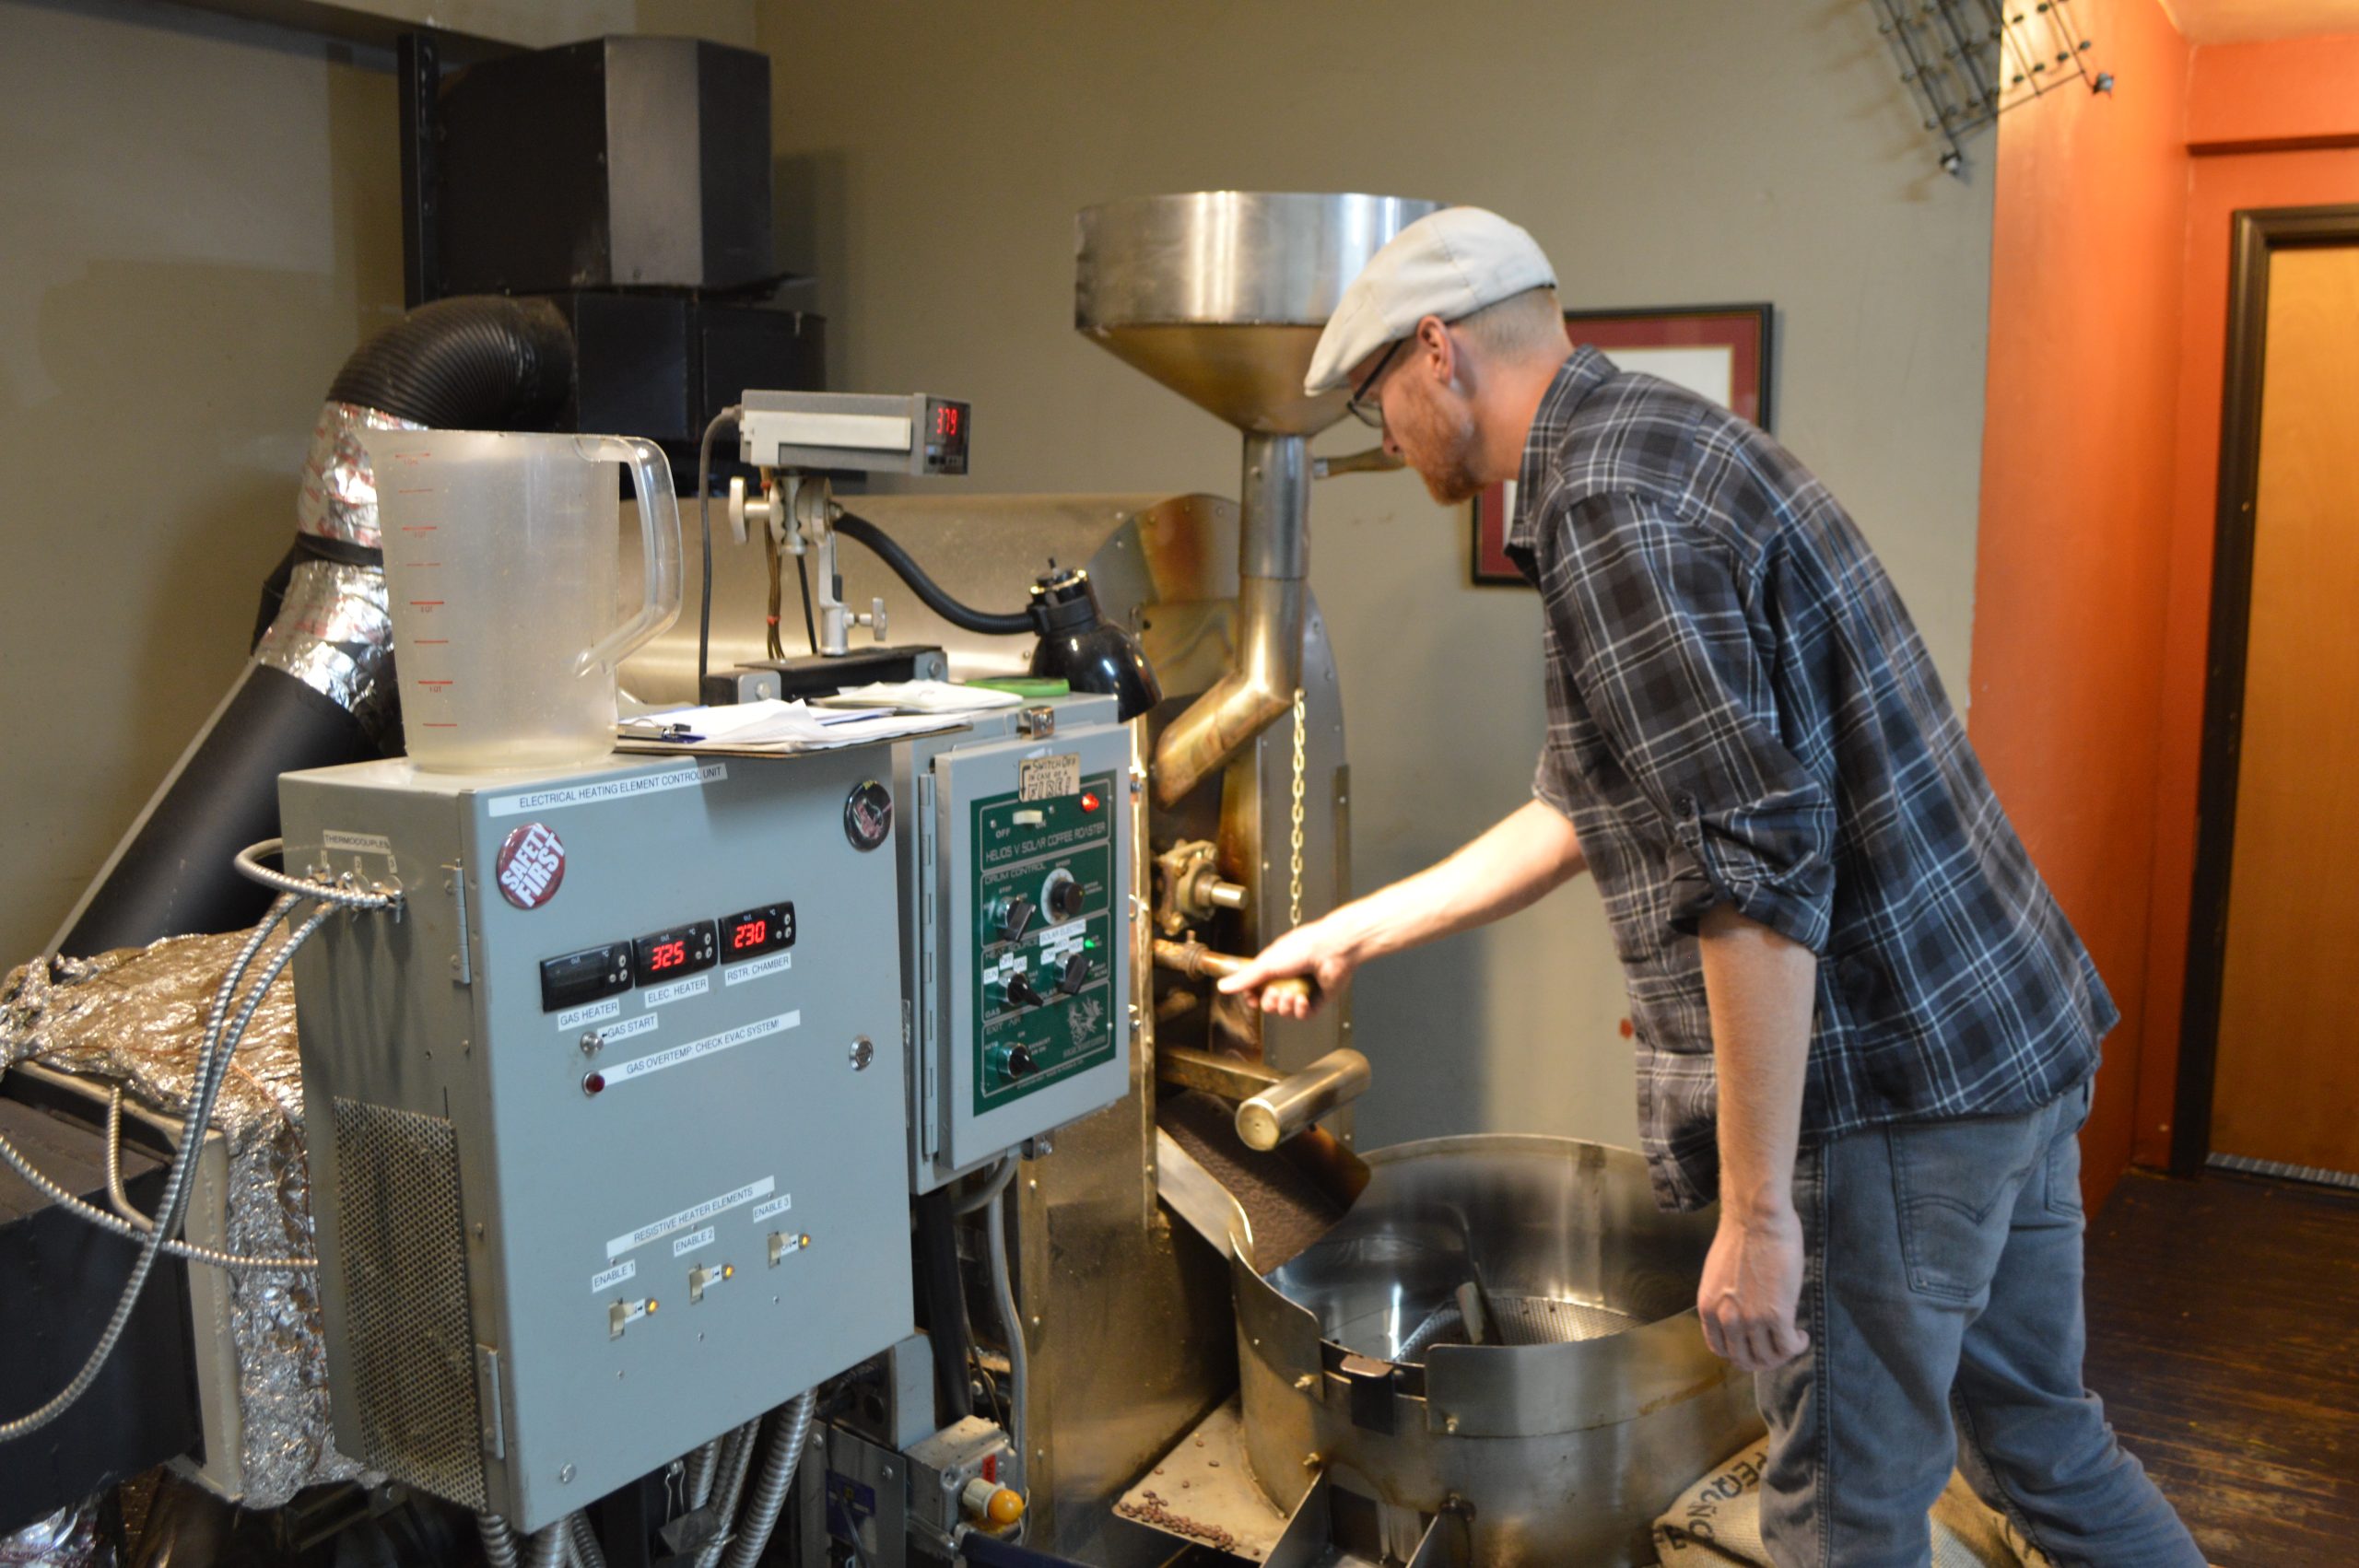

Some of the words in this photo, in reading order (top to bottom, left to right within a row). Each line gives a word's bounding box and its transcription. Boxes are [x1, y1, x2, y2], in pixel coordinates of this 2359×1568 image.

[520, 791, 576, 808] ELECTRICAL
[579, 785, 618, 800] HEATING
[619, 779, 660, 792] ELEMENT
[662, 772, 700, 786] CONTROL
[703, 766, 722, 778] UNIT
[1037, 772, 1051, 780] CASE
[324, 835, 391, 848] THERMOCOUPLES
[986, 846, 1012, 861] HELIOS
[1022, 837, 1046, 853] SOLAR
[1048, 829, 1074, 847] COFFEE
[1074, 822, 1106, 838] ROASTER
[995, 827, 1011, 838] OFF
[500, 822, 550, 891] SAFETY
[515, 831, 565, 907] FIRST
[1011, 862, 1047, 879] CONTROL
[734, 920, 766, 948] 230
[651, 940, 685, 970] 325
[727, 970, 750, 982] RSTR.
[752, 957, 790, 975] CHAMBER
[648, 989, 672, 1002] ELEC.
[674, 979, 707, 995] HEATER
[560, 1013, 580, 1025] GAS
[581, 1002, 618, 1019] HEATER
[607, 1025, 627, 1038] GAS
[628, 1016, 656, 1032] START
[627, 1060, 645, 1074] GAS
[696, 1037, 723, 1053] CHECK
[724, 1030, 745, 1045] EVAC
[747, 1020, 780, 1038] SYSTEM!
[633, 1218, 676, 1244] RESISTIVE
[678, 1202, 711, 1223] HEATER
[712, 1187, 754, 1211] ELEMENTS
[754, 1202, 782, 1218] ENABLE
[675, 1235, 705, 1253] ENABLE
[707, 1229, 714, 1240] 2
[593, 1268, 627, 1288] ENABLE
